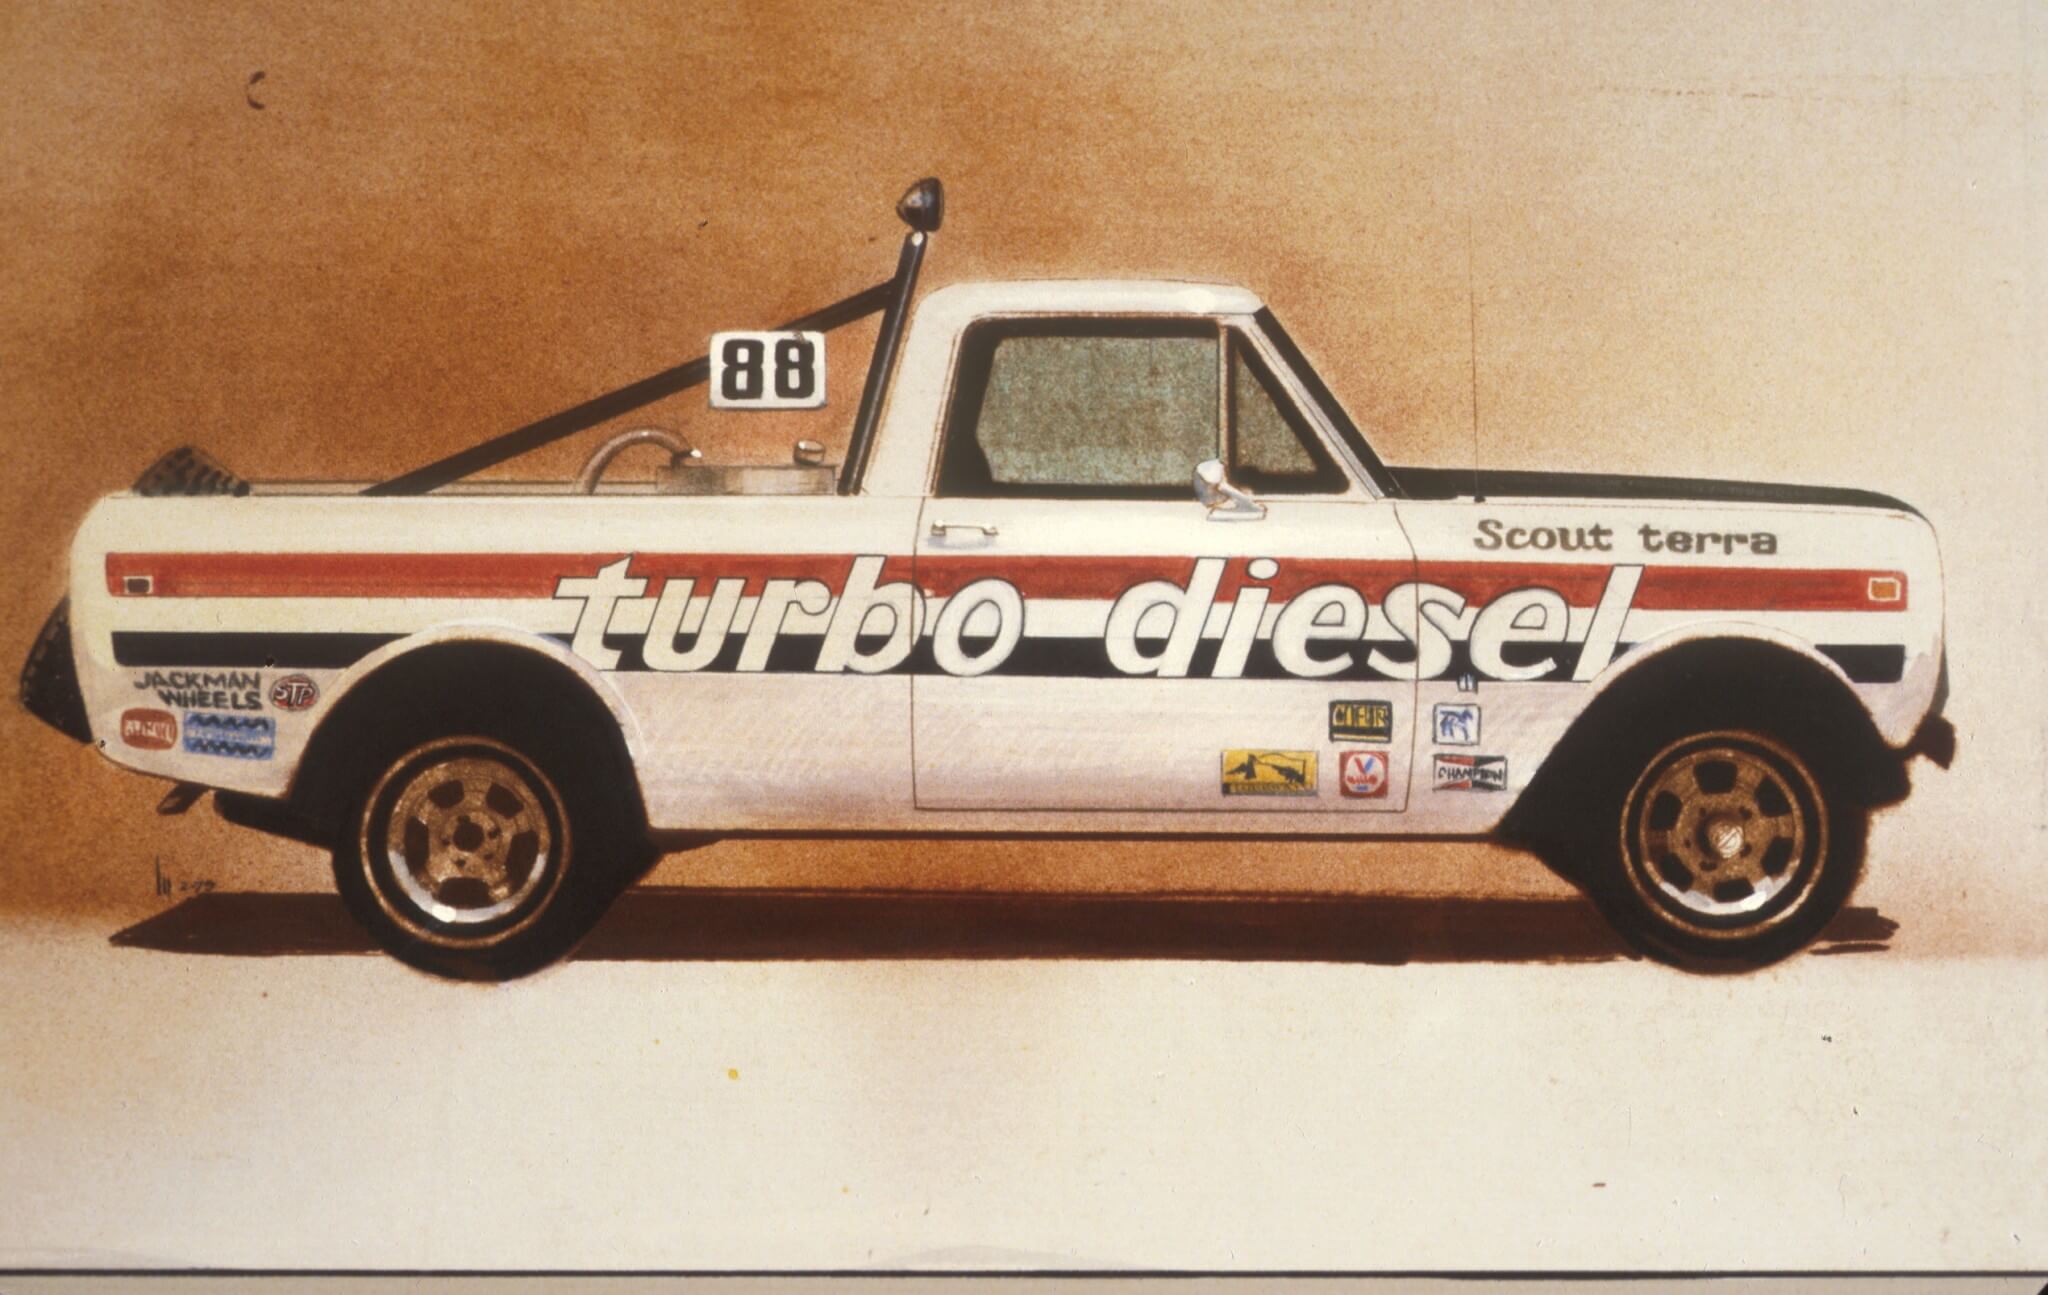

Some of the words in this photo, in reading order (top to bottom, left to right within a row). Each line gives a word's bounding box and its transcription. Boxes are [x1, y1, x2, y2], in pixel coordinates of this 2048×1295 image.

[721, 338, 815, 400] 88
[1473, 519, 1613, 551] Scout
[1638, 523, 1778, 556] terra
[554, 552, 1026, 677] turbo
[1104, 556, 1645, 682] diesel
[133, 671, 261, 690] JACKMAN
[272, 681, 313, 705] STP
[158, 690, 263, 710] WHEELS
